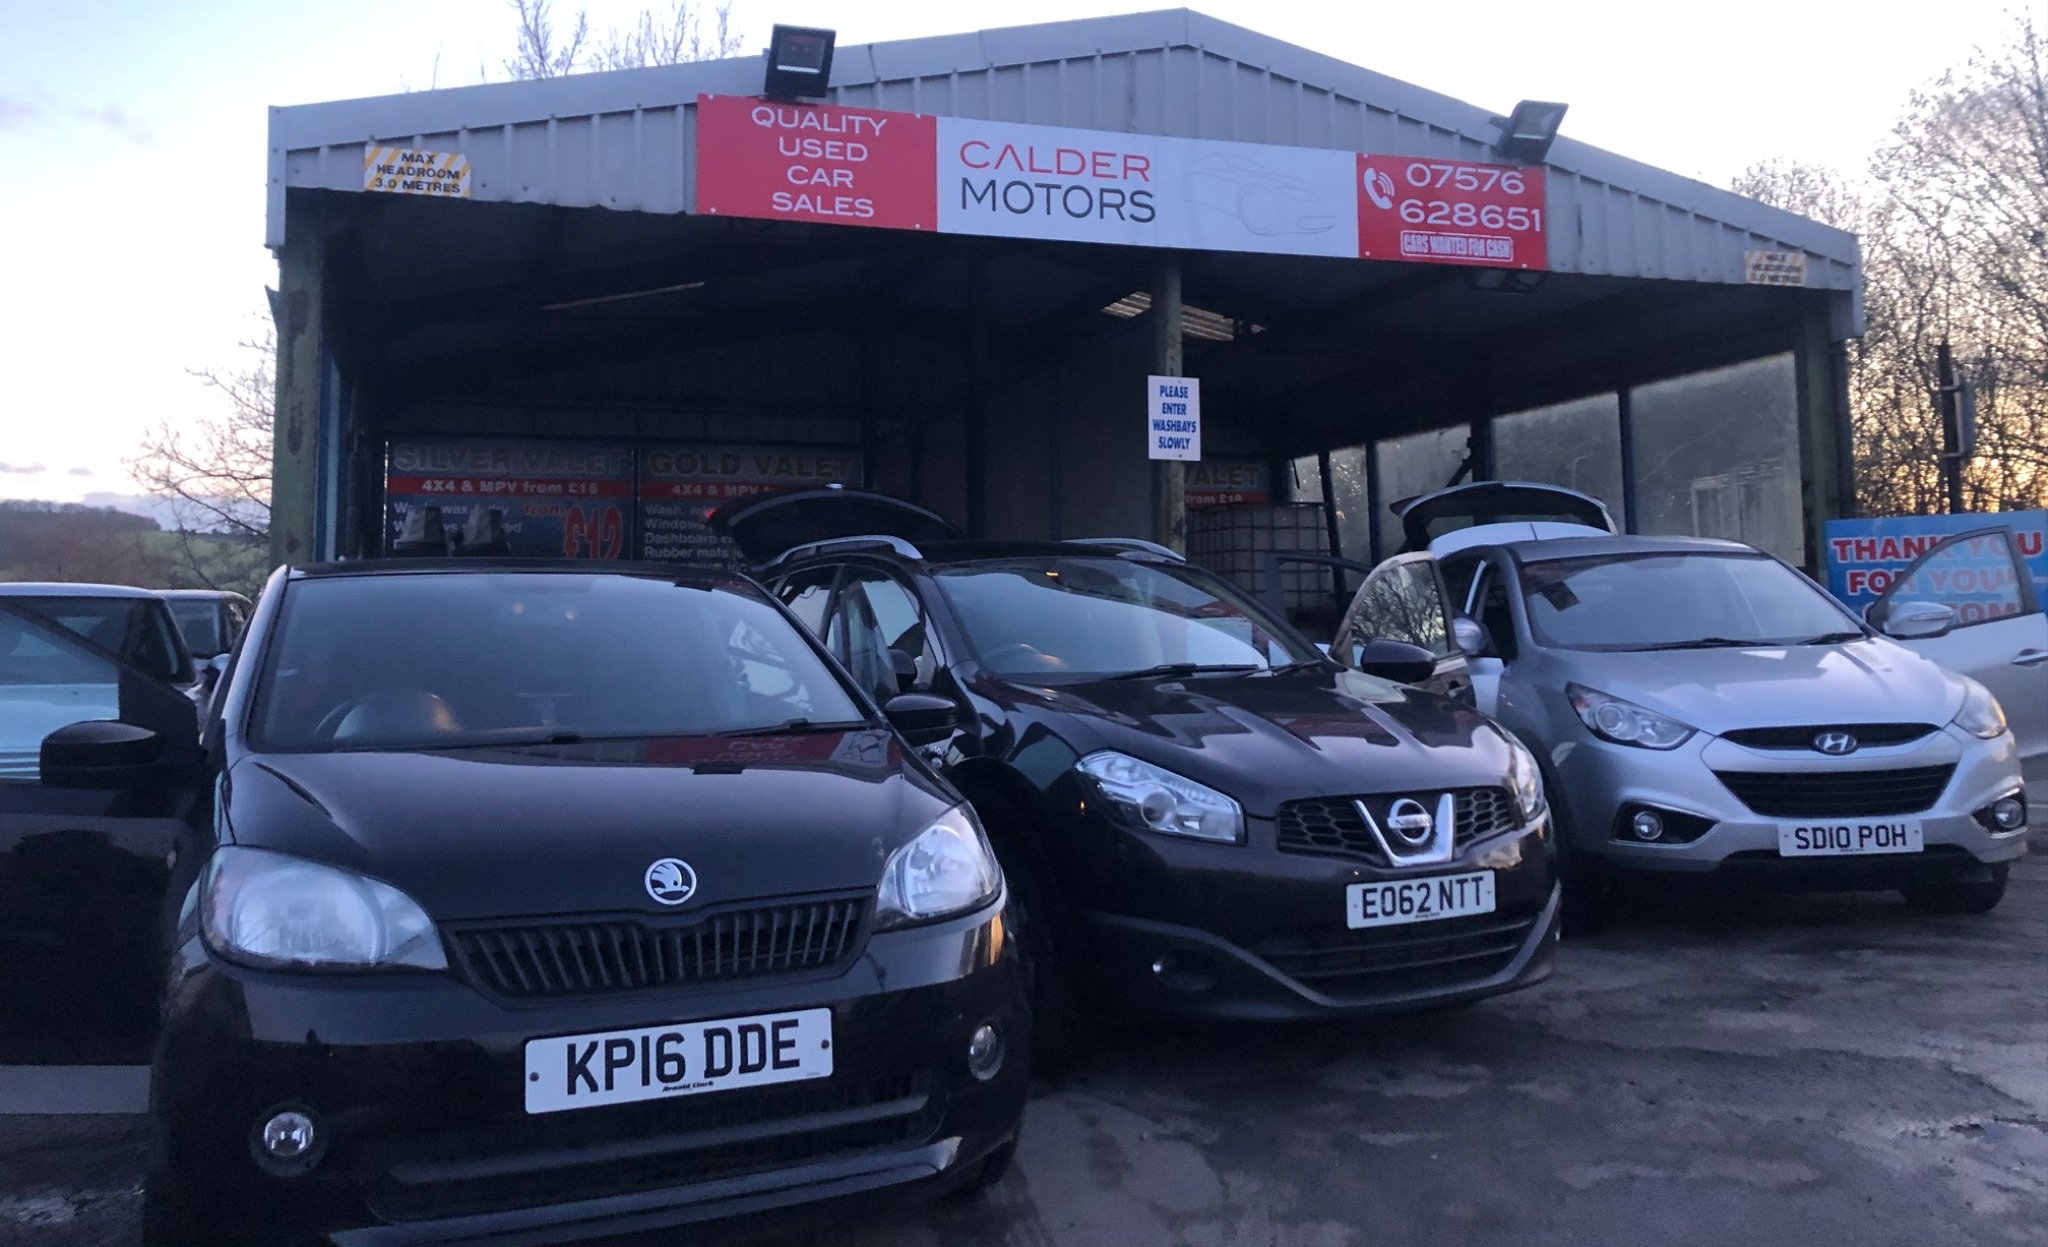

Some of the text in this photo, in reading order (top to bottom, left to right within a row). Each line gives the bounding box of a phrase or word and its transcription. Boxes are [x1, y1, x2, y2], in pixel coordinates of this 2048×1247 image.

[751, 106, 888, 137] QUALITY
[401, 152, 435, 164] MAX
[778, 136, 869, 163] USED
[959, 140, 1151, 182] CALDER
[376, 164, 460, 179] HEADROOM
[786, 165, 854, 189] CAR
[1406, 163, 1525, 195] 07576
[375, 177, 461, 193] 3.0 METRES
[772, 191, 875, 218] SALES
[960, 177, 1156, 223] MOTORS
[1400, 199, 1541, 232] 628651
[1160, 385, 1188, 399] PLEASE
[1162, 402, 1187, 415] ENTER
[1152, 419, 1197, 433] WASHBAYS
[1158, 436, 1191, 450] SLOWLY
[648, 450, 855, 479] GOLD VALET
[421, 479, 456, 493] 4X4
[461, 480, 474, 493] &
[479, 480, 517, 493] MPV
[523, 480, 563, 494] from
[644, 546, 693, 558] Rubber
[1794, 824, 1907, 850] SD10 POH
[1362, 876, 1484, 919] EO62 NTT
[566, 1018, 800, 1096] KP16 DDE
